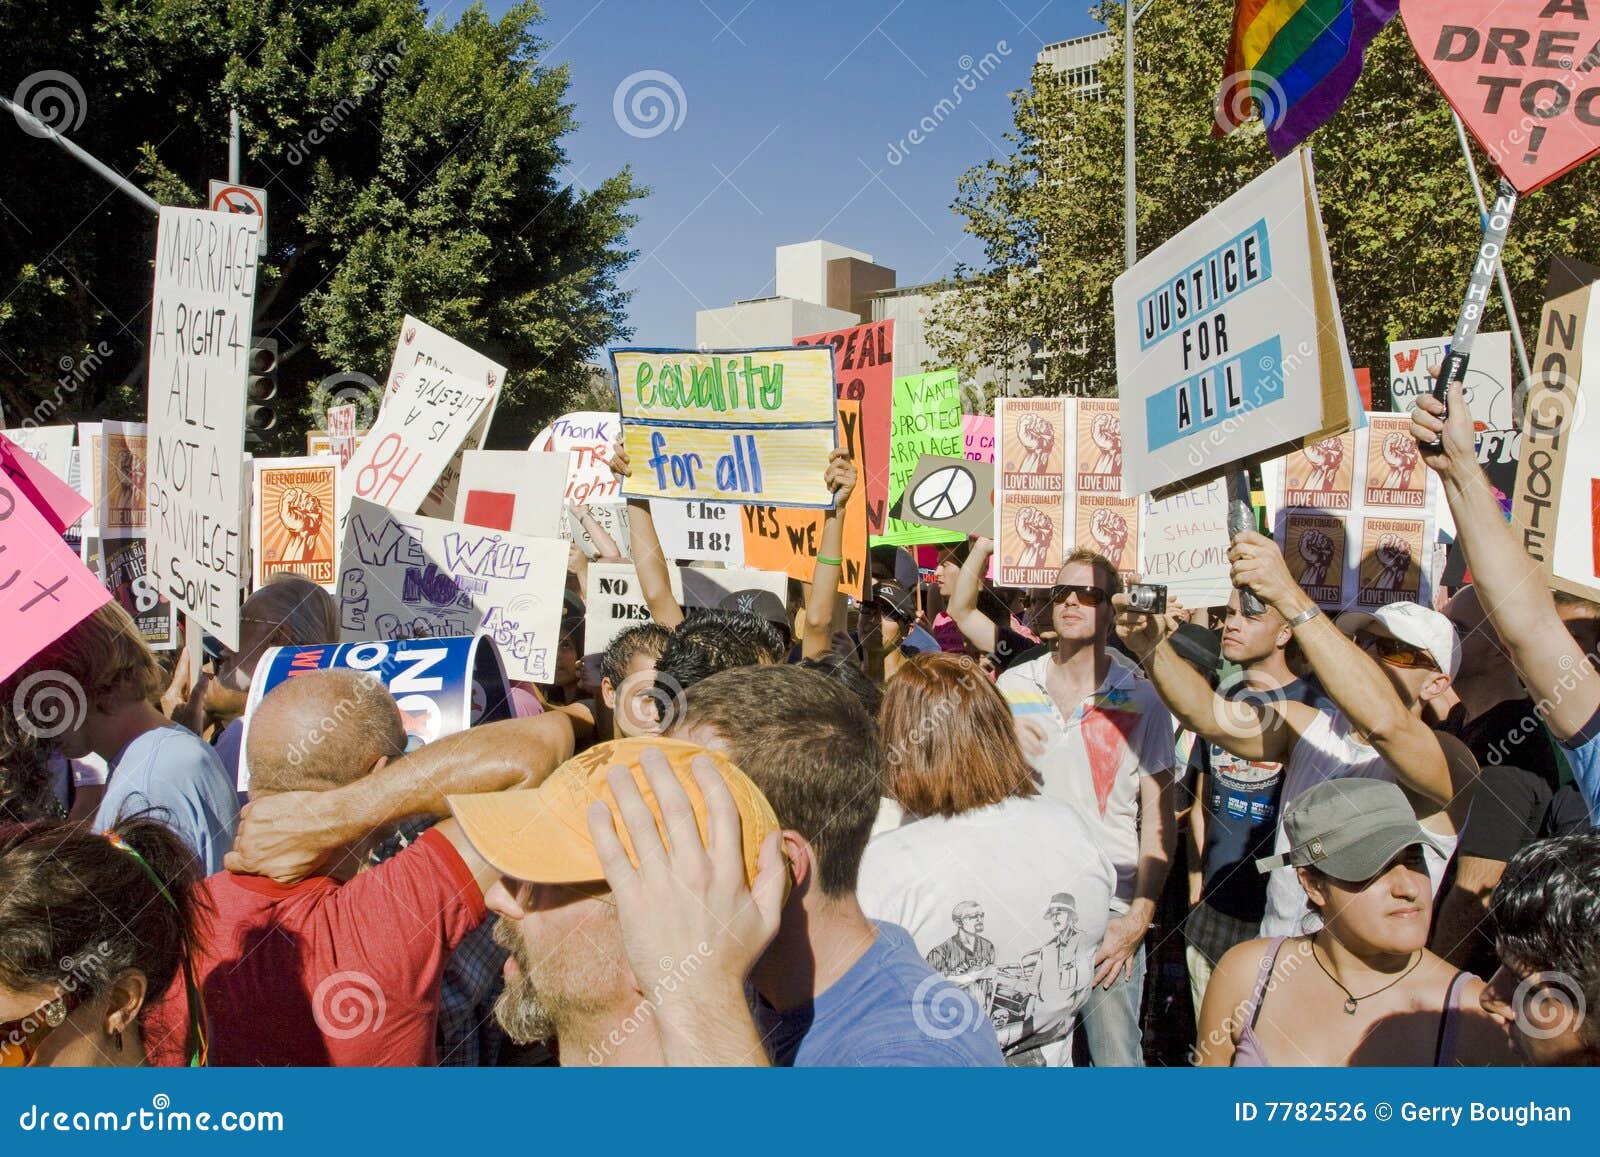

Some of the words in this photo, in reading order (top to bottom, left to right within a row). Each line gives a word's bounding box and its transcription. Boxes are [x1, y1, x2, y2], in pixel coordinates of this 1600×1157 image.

[1490, 196, 1514, 232] NO
[160, 215, 258, 299] MARRIAGE
[1475, 243, 1499, 276] ON
[1145, 236, 1258, 340] JUSTICE
[153, 296, 166, 360] A
[175, 302, 226, 357] RIGHT
[228, 313, 246, 369] 4
[797, 325, 893, 371] PEAL
[1182, 312, 1229, 371] FOR
[167, 358, 215, 430] ALL
[636, 355, 784, 412] equality
[905, 376, 956, 405] WANT
[1178, 366, 1241, 429] ALL
[901, 406, 960, 436] PROTECT
[1031, 401, 1062, 411] EQUALITY
[648, 432, 703, 491] for
[715, 434, 763, 494] all
[890, 435, 961, 464] ARRIAGE
[157, 436, 200, 499] NOT
[208, 444, 224, 501] A
[266, 472, 294, 486] DEFEND
[295, 471, 331, 484] EQUALITY
[1005, 475, 1028, 490] LOVE
[1029, 475, 1062, 490] UNITES
[1079, 475, 1102, 490] LOVE
[564, 474, 620, 506] ight
[1031, 494, 1062, 505] EQUALITY
[1288, 491, 1312, 507] LOVE
[1313, 492, 1349, 508] UNITES
[1367, 490, 1390, 503] LOVE
[1391, 491, 1423, 504] UNITES
[686, 501, 726, 520] the
[743, 504, 780, 540] YES
[1391, 521, 1423, 532] EQUALITY
[149, 481, 238, 578] PRIVILEGE
[351, 513, 426, 567] WE
[785, 521, 818, 557] WE
[1163, 520, 1225, 541] SHALL
[265, 563, 291, 578] LOVE
[292, 561, 332, 580] UNITES
[1003, 569, 1027, 583] LOVE
[1143, 544, 1230, 576] VERCOME
[169, 557, 222, 628] SOME
[599, 578, 629, 596] NO
[1361, 588, 1383, 602] LOVE
